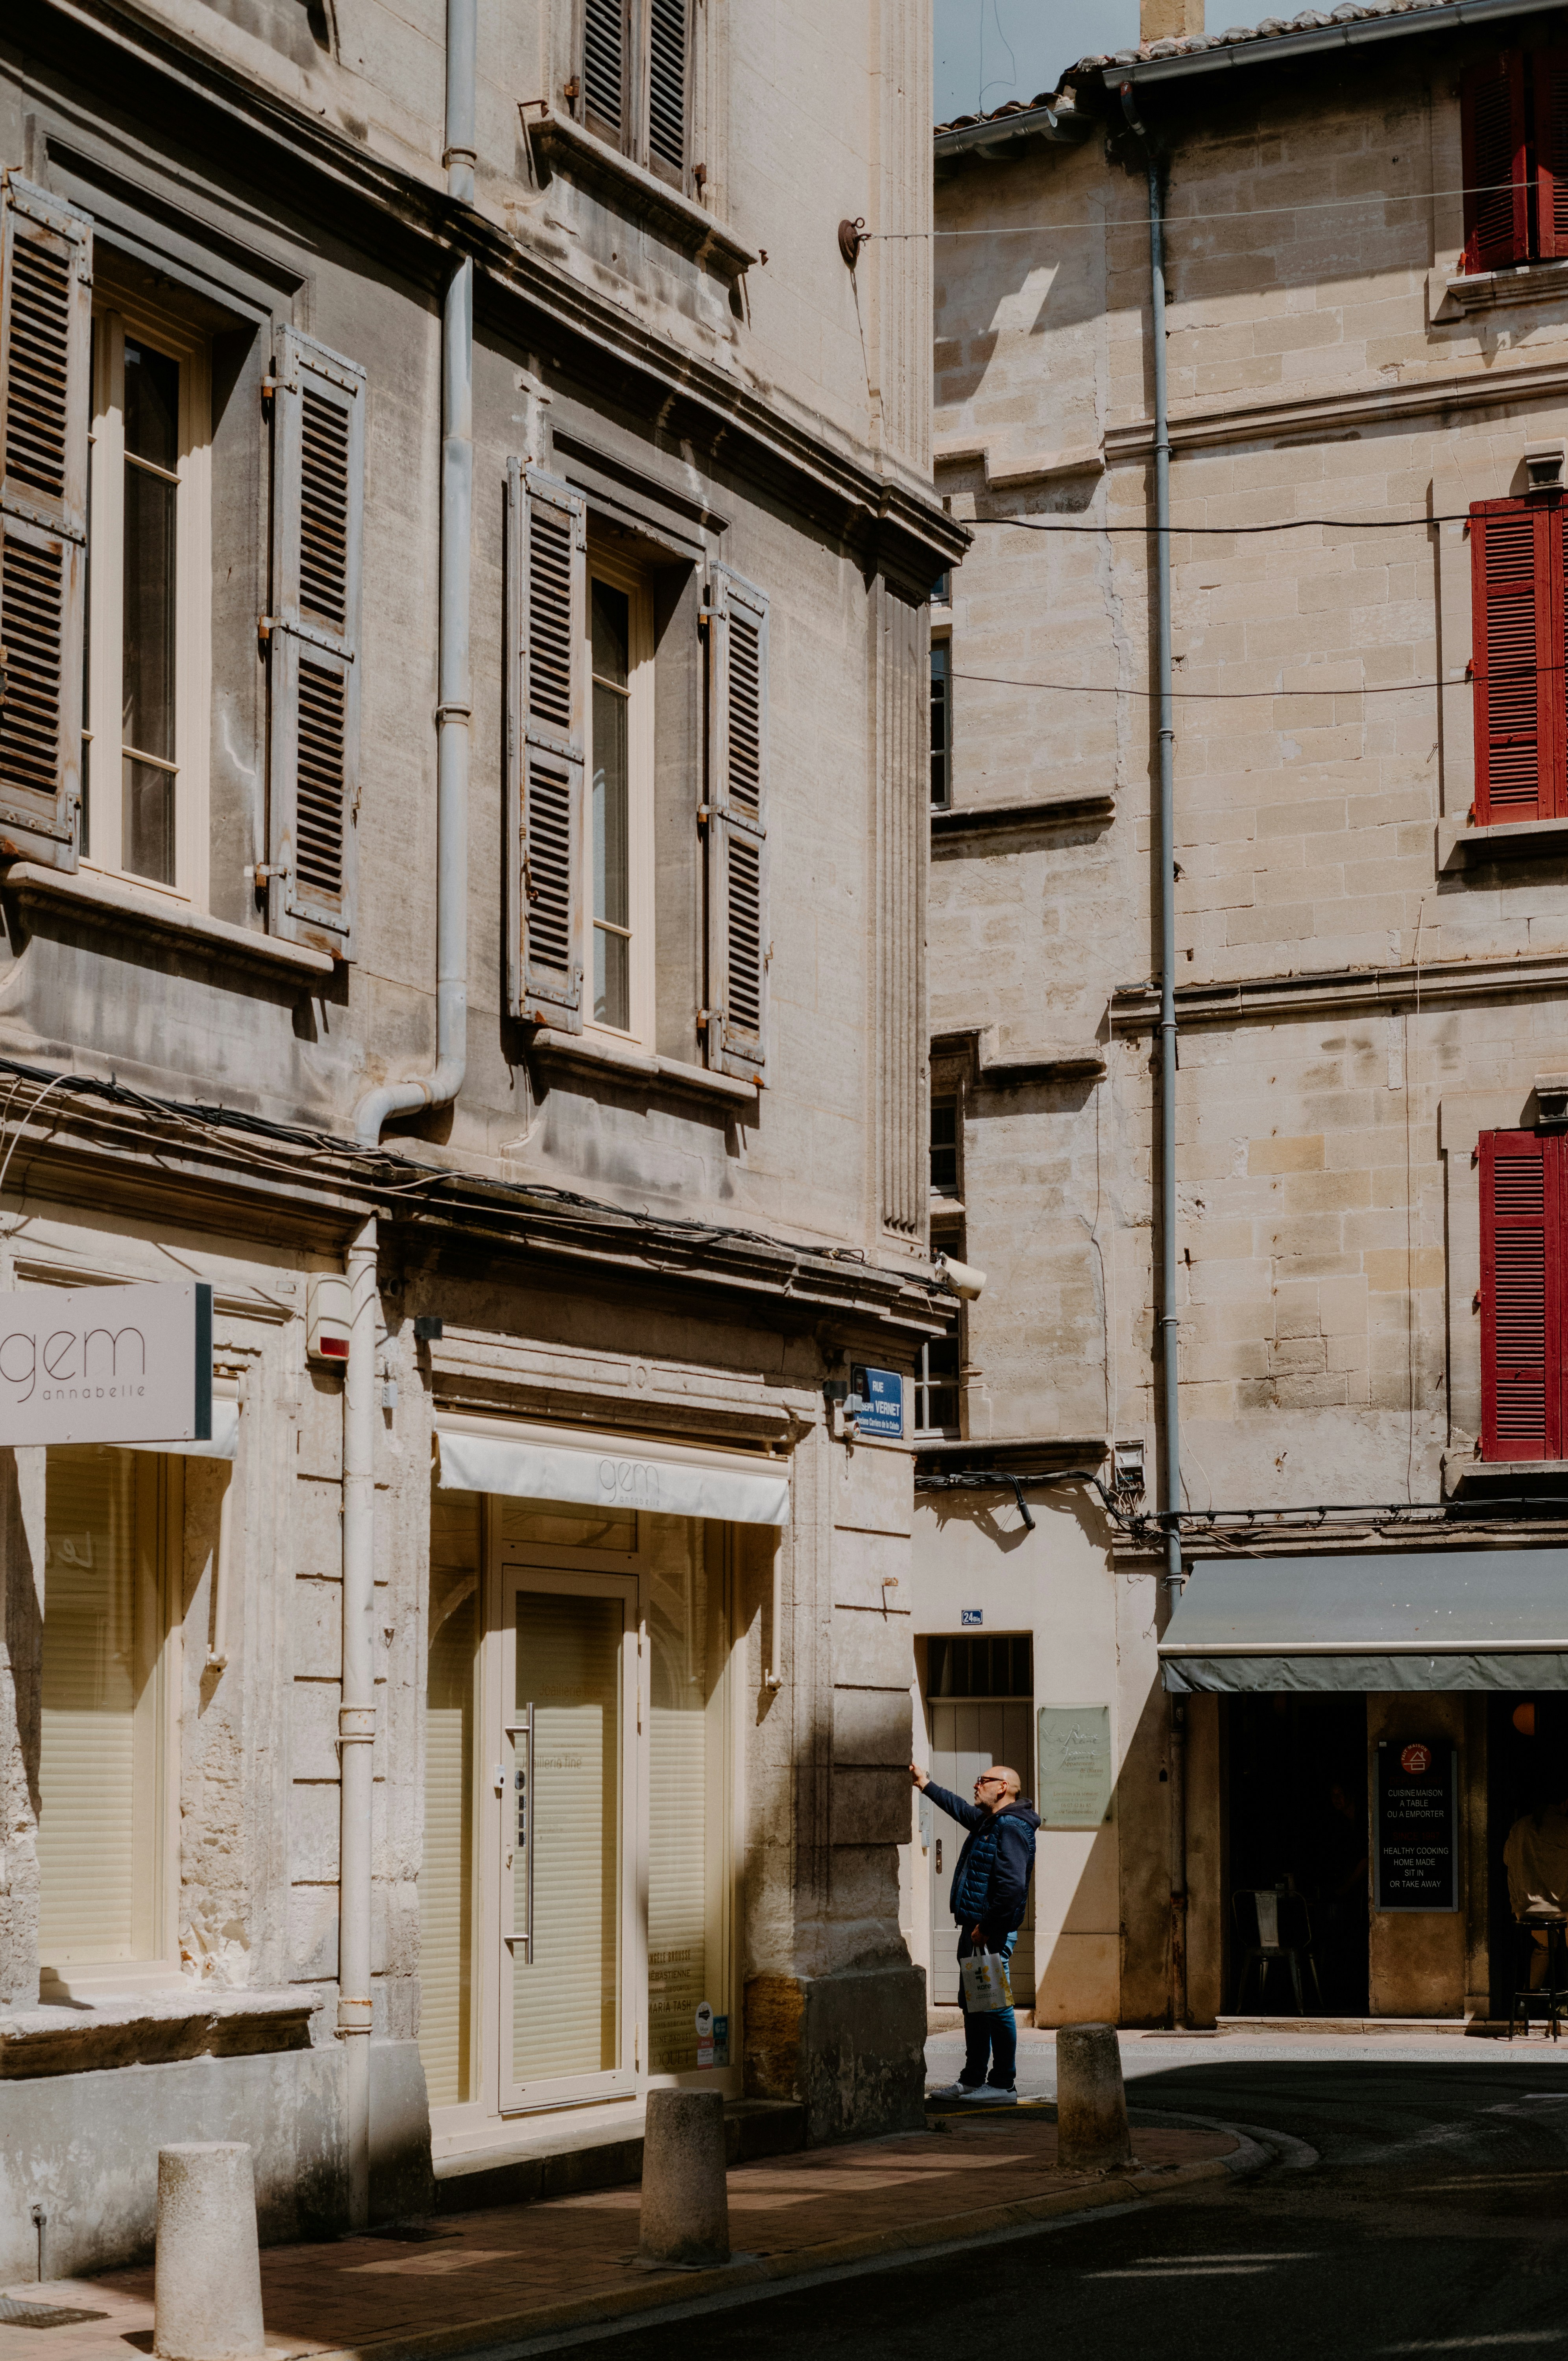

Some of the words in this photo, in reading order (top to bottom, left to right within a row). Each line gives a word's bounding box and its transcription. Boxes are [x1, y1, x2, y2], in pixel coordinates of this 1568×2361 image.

[0, 1328, 145, 1402] gem
[42, 1385, 145, 1400] annabelle
[872, 1380, 884, 1393] RUE
[862, 1402, 874, 1412] SEPH
[875, 1400, 900, 1417] VERNET
[599, 1459, 659, 1502] gem
[620, 1496, 660, 1507] annabelle
[1407, 1744, 1428, 1752] MAISON
[1389, 1776, 1421, 1786] DEPUIS
[1393, 1832, 1419, 1841] SINCE
[668, 1949, 691, 1962] BROUSSE
[673, 1999, 691, 2012] TASH
